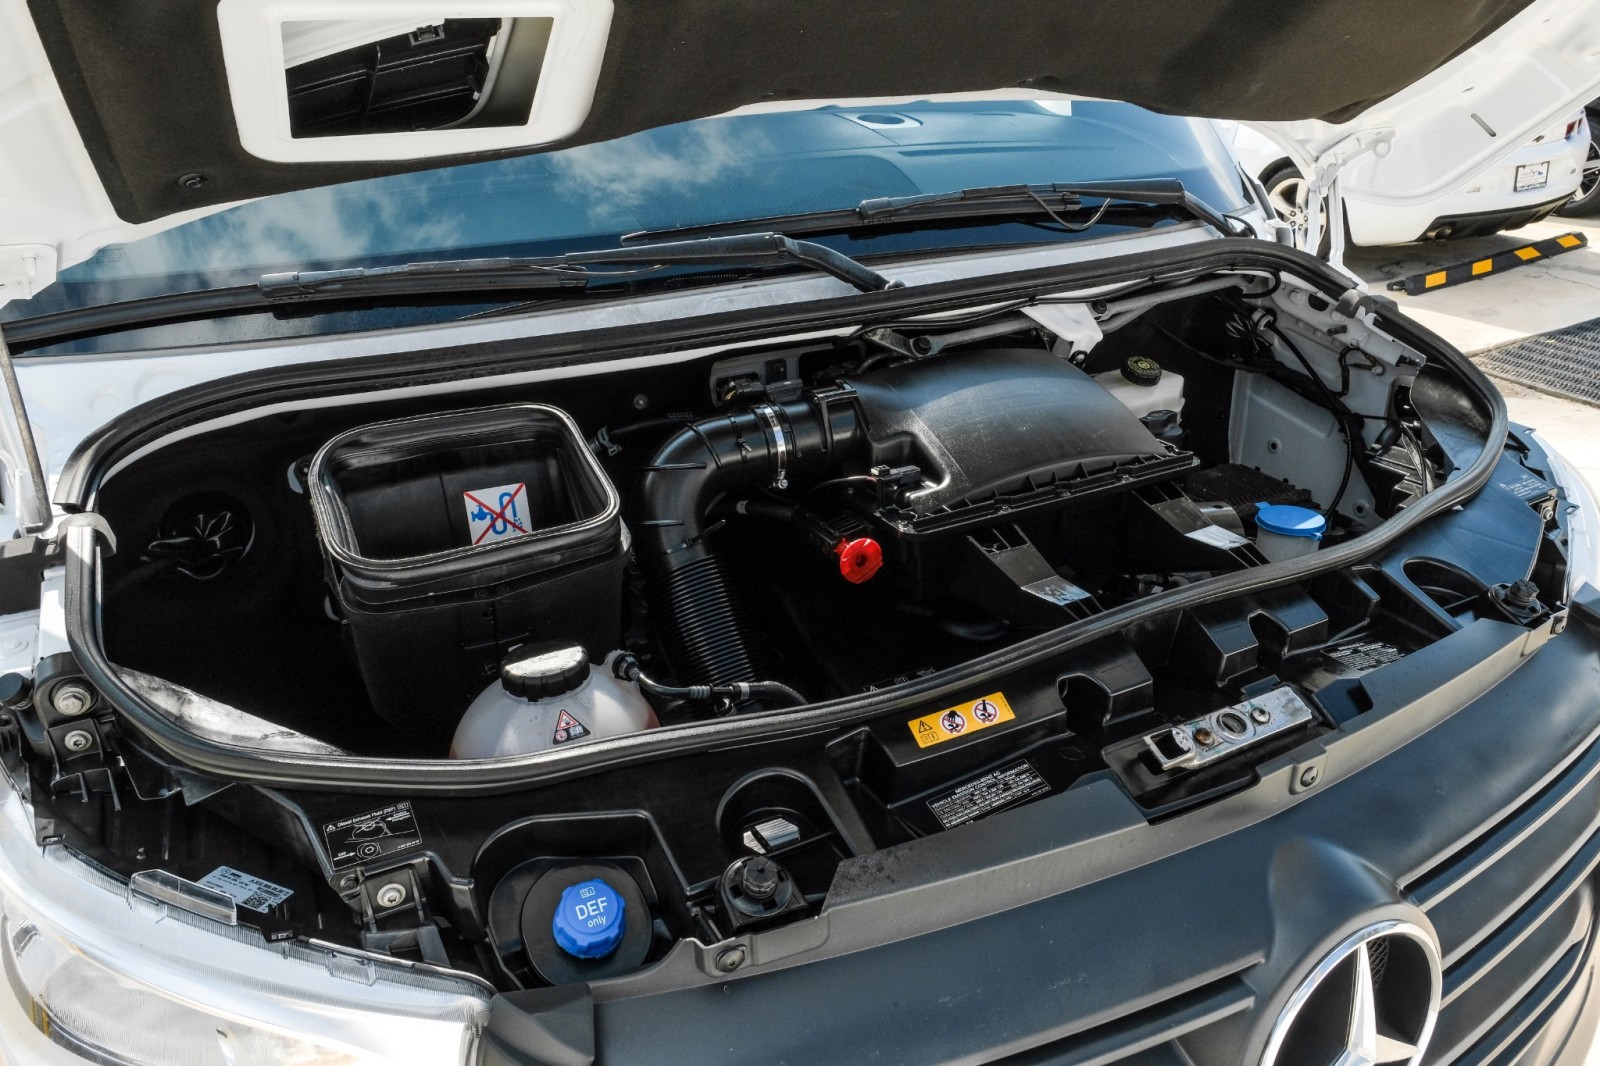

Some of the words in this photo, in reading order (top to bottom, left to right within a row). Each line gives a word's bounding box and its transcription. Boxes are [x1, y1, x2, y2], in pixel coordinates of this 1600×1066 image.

[931, 797, 951, 808] VEHICLE
[951, 788, 975, 800] EMISSION
[974, 778, 997, 790] CONTROL
[996, 764, 1030, 779] INFORMATION
[336, 819, 353, 828] Diesel
[352, 814, 372, 823] Exhaust
[371, 810, 383, 818] Fluid
[575, 896, 608, 920] DEF
[587, 915, 606, 928] only
